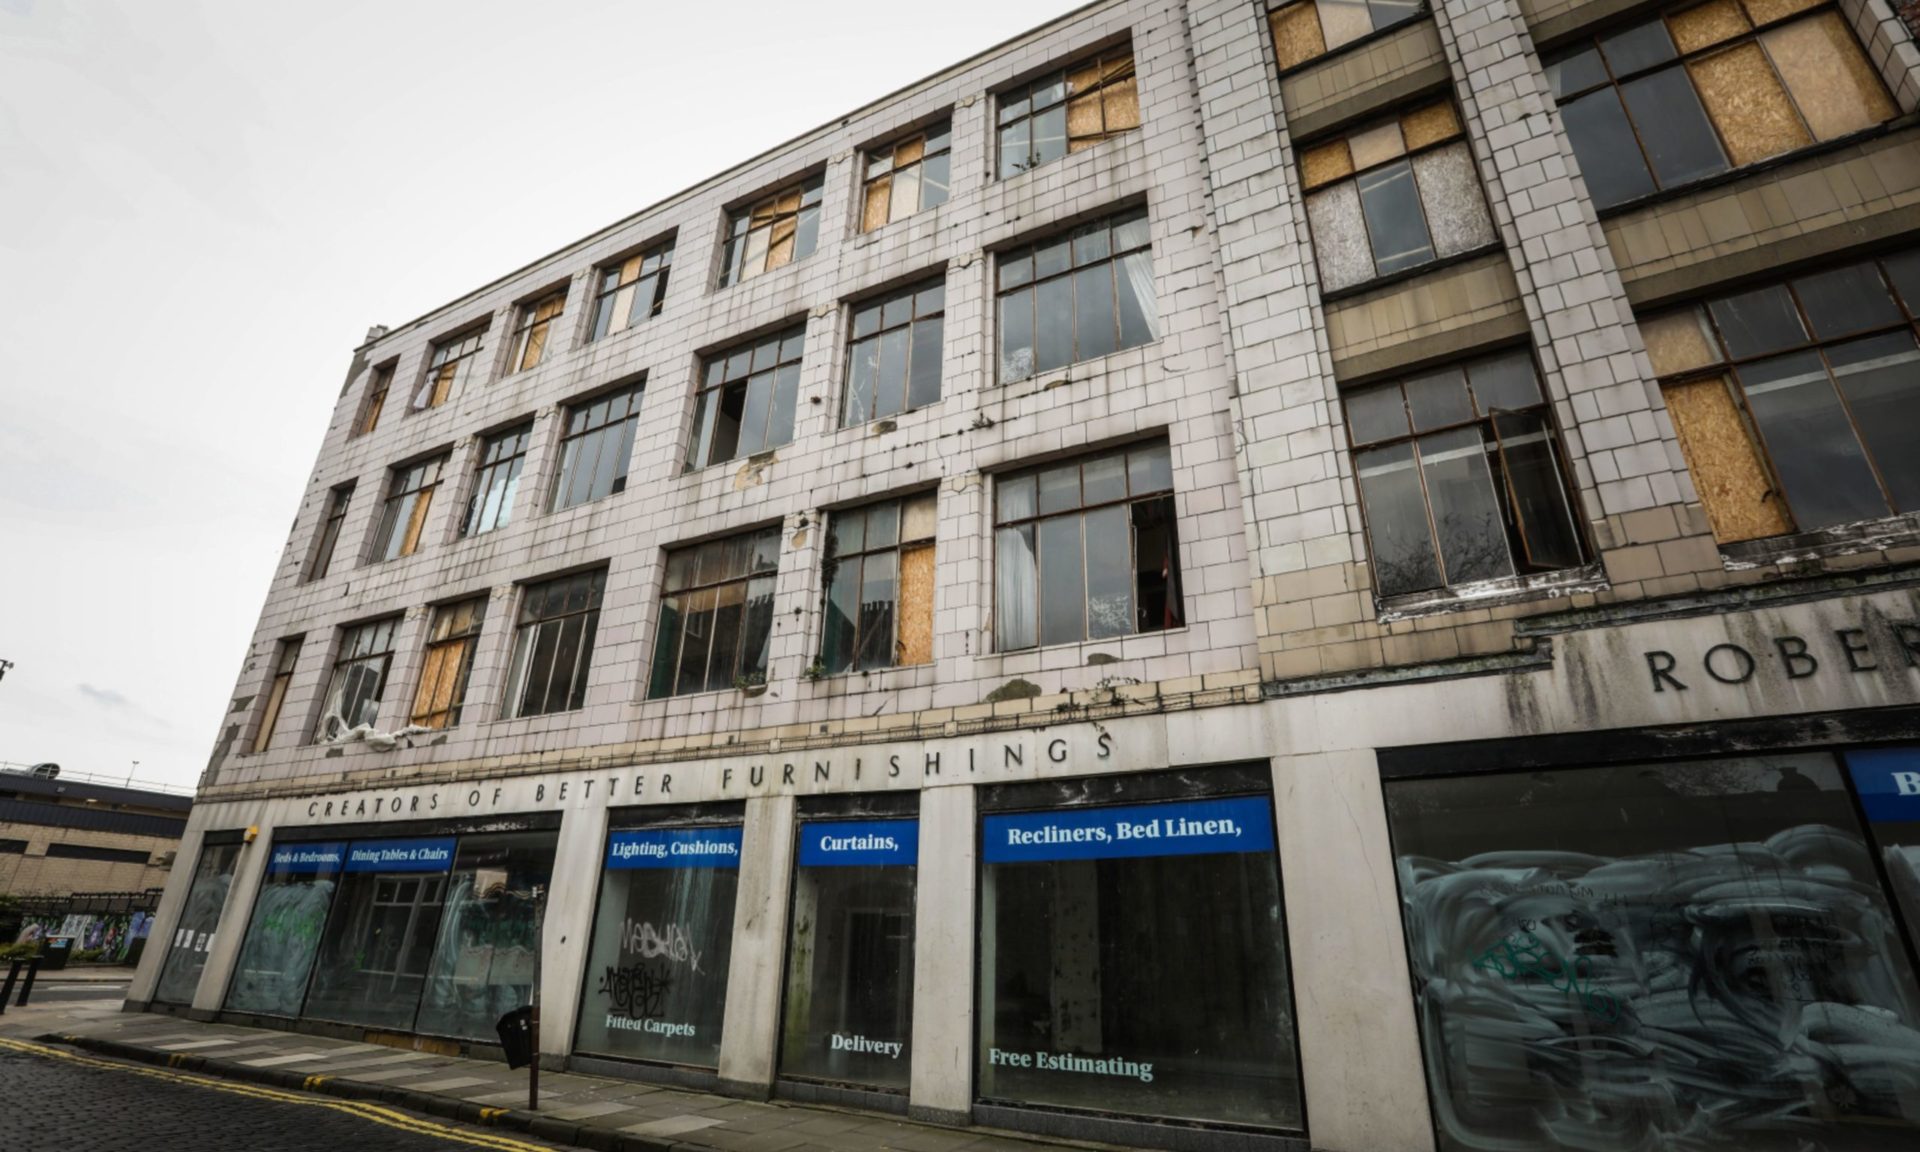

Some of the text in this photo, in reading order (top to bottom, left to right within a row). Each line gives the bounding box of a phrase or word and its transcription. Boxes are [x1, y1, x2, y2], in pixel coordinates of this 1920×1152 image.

[1644, 623, 1920, 692] ROBER
[308, 735, 1112, 817] CREATORS OF BETTER FURNISHINGS
[820, 834, 899, 853] Curtains,
[1007, 816, 1242, 846] Recliners, Bed Linen,
[351, 847, 448, 863] Dining Tables & Chairs
[612, 839, 738, 860] Lighting, Cushions,
[605, 1015, 696, 1038] Fitted Carpets
[831, 1034, 903, 1059] Delivery
[988, 1048, 1154, 1082] Free Estimating
